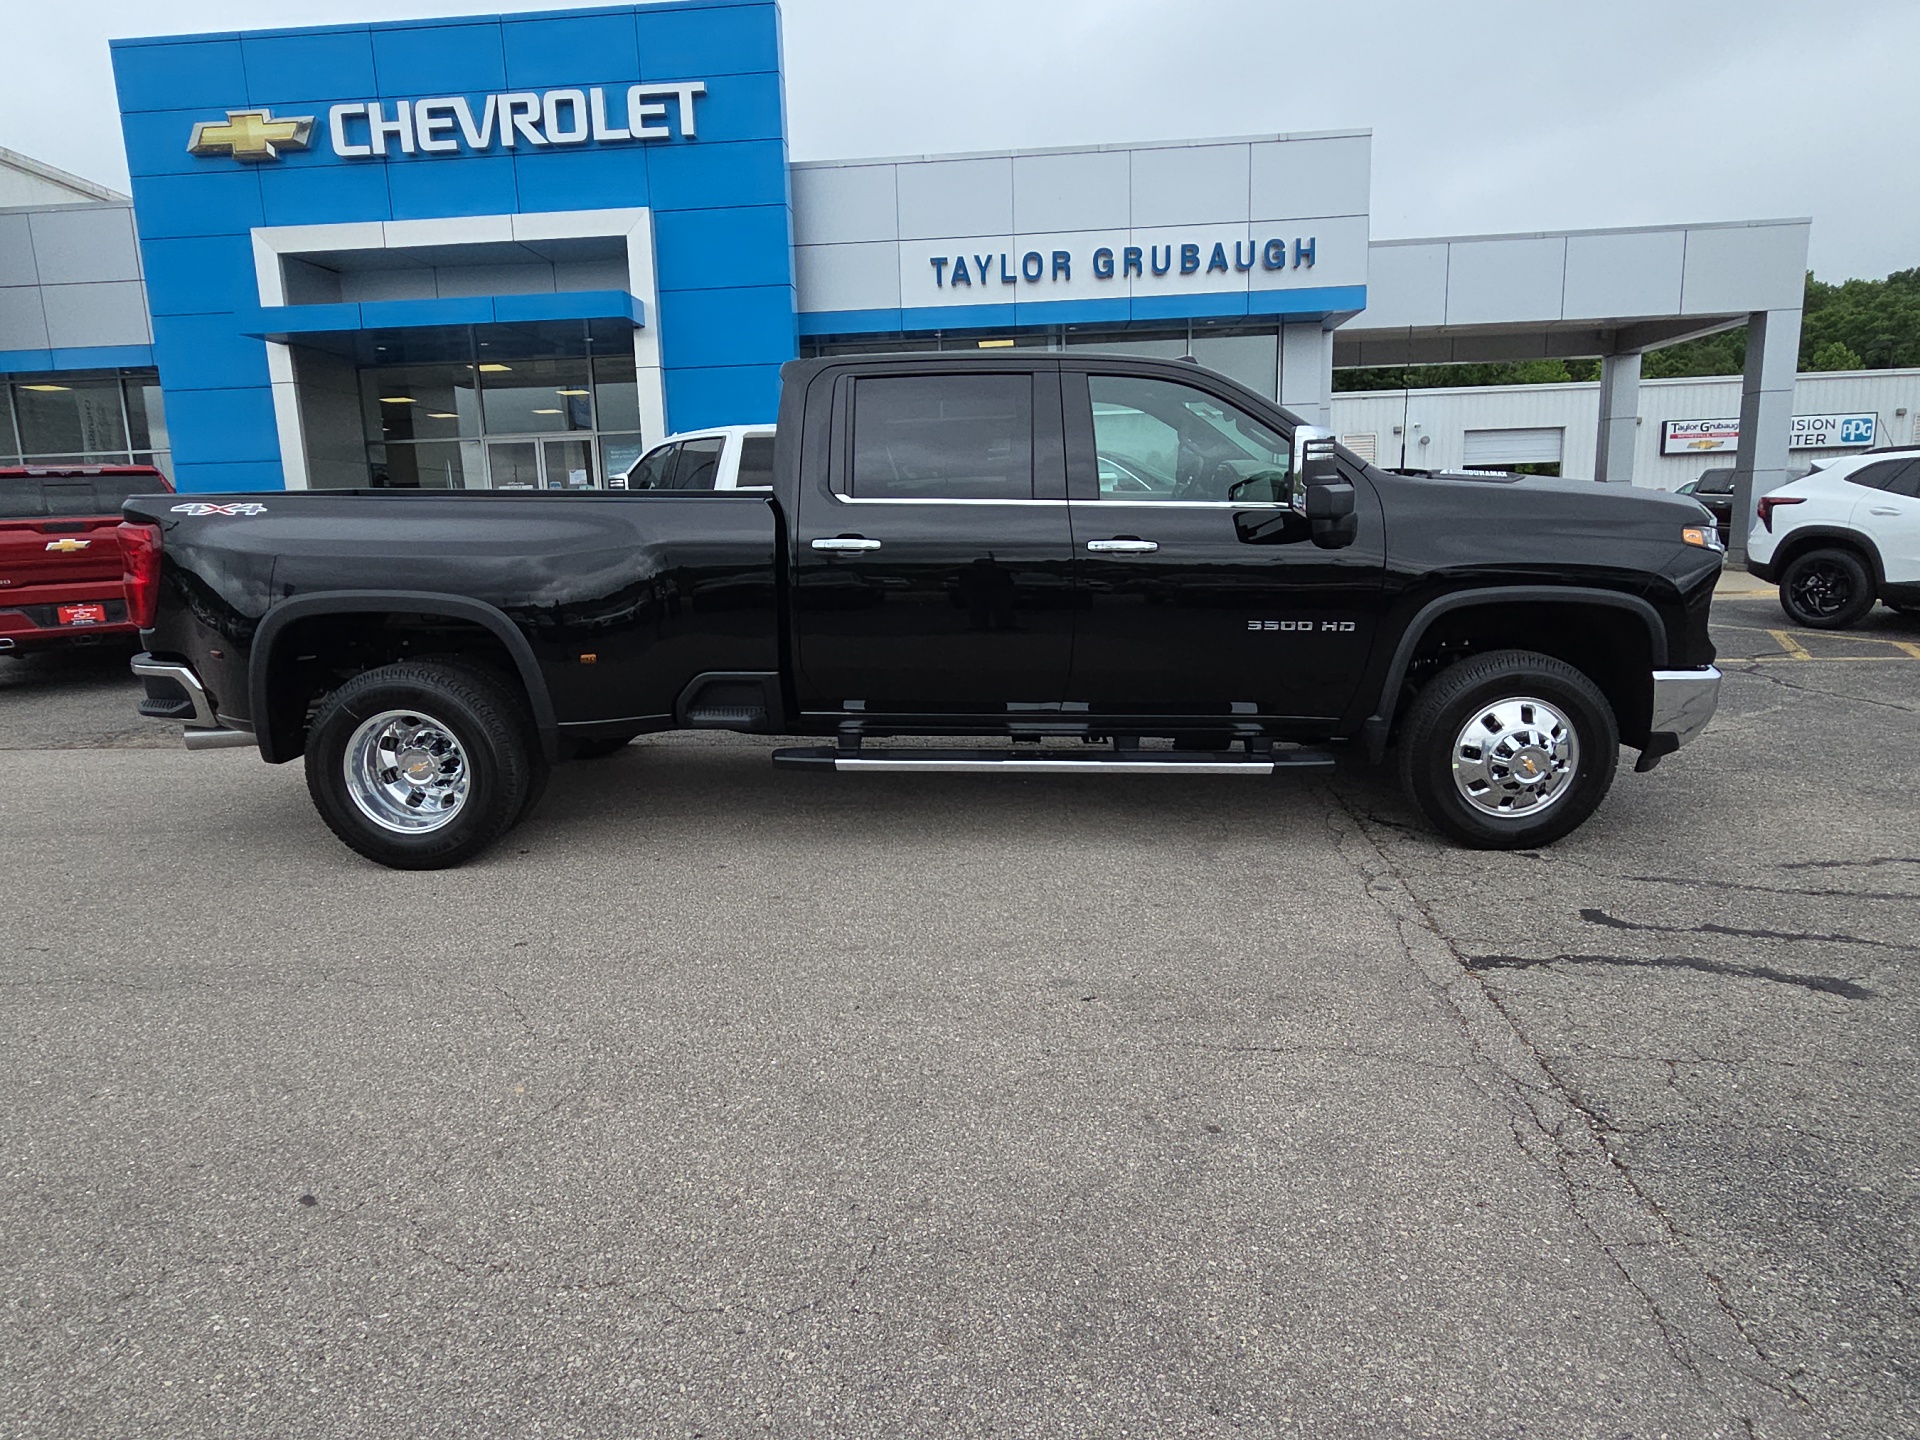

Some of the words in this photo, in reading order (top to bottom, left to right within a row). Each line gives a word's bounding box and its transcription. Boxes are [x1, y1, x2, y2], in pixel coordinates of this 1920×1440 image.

[329, 81, 705, 158] CHEVROLET
[930, 250, 1073, 287] TAYLOR
[1093, 237, 1317, 279] GRUBAUGH
[1671, 423, 1699, 433] Taylor
[1700, 422, 1738, 432] Grubaug
[1791, 419, 1836, 431] ISION
[1842, 420, 1872, 440] PPG
[1789, 433, 1826, 446] TER
[170, 503, 268, 516] 4X4
[1247, 620, 1313, 631] 3500
[1321, 621, 1355, 632] HD
